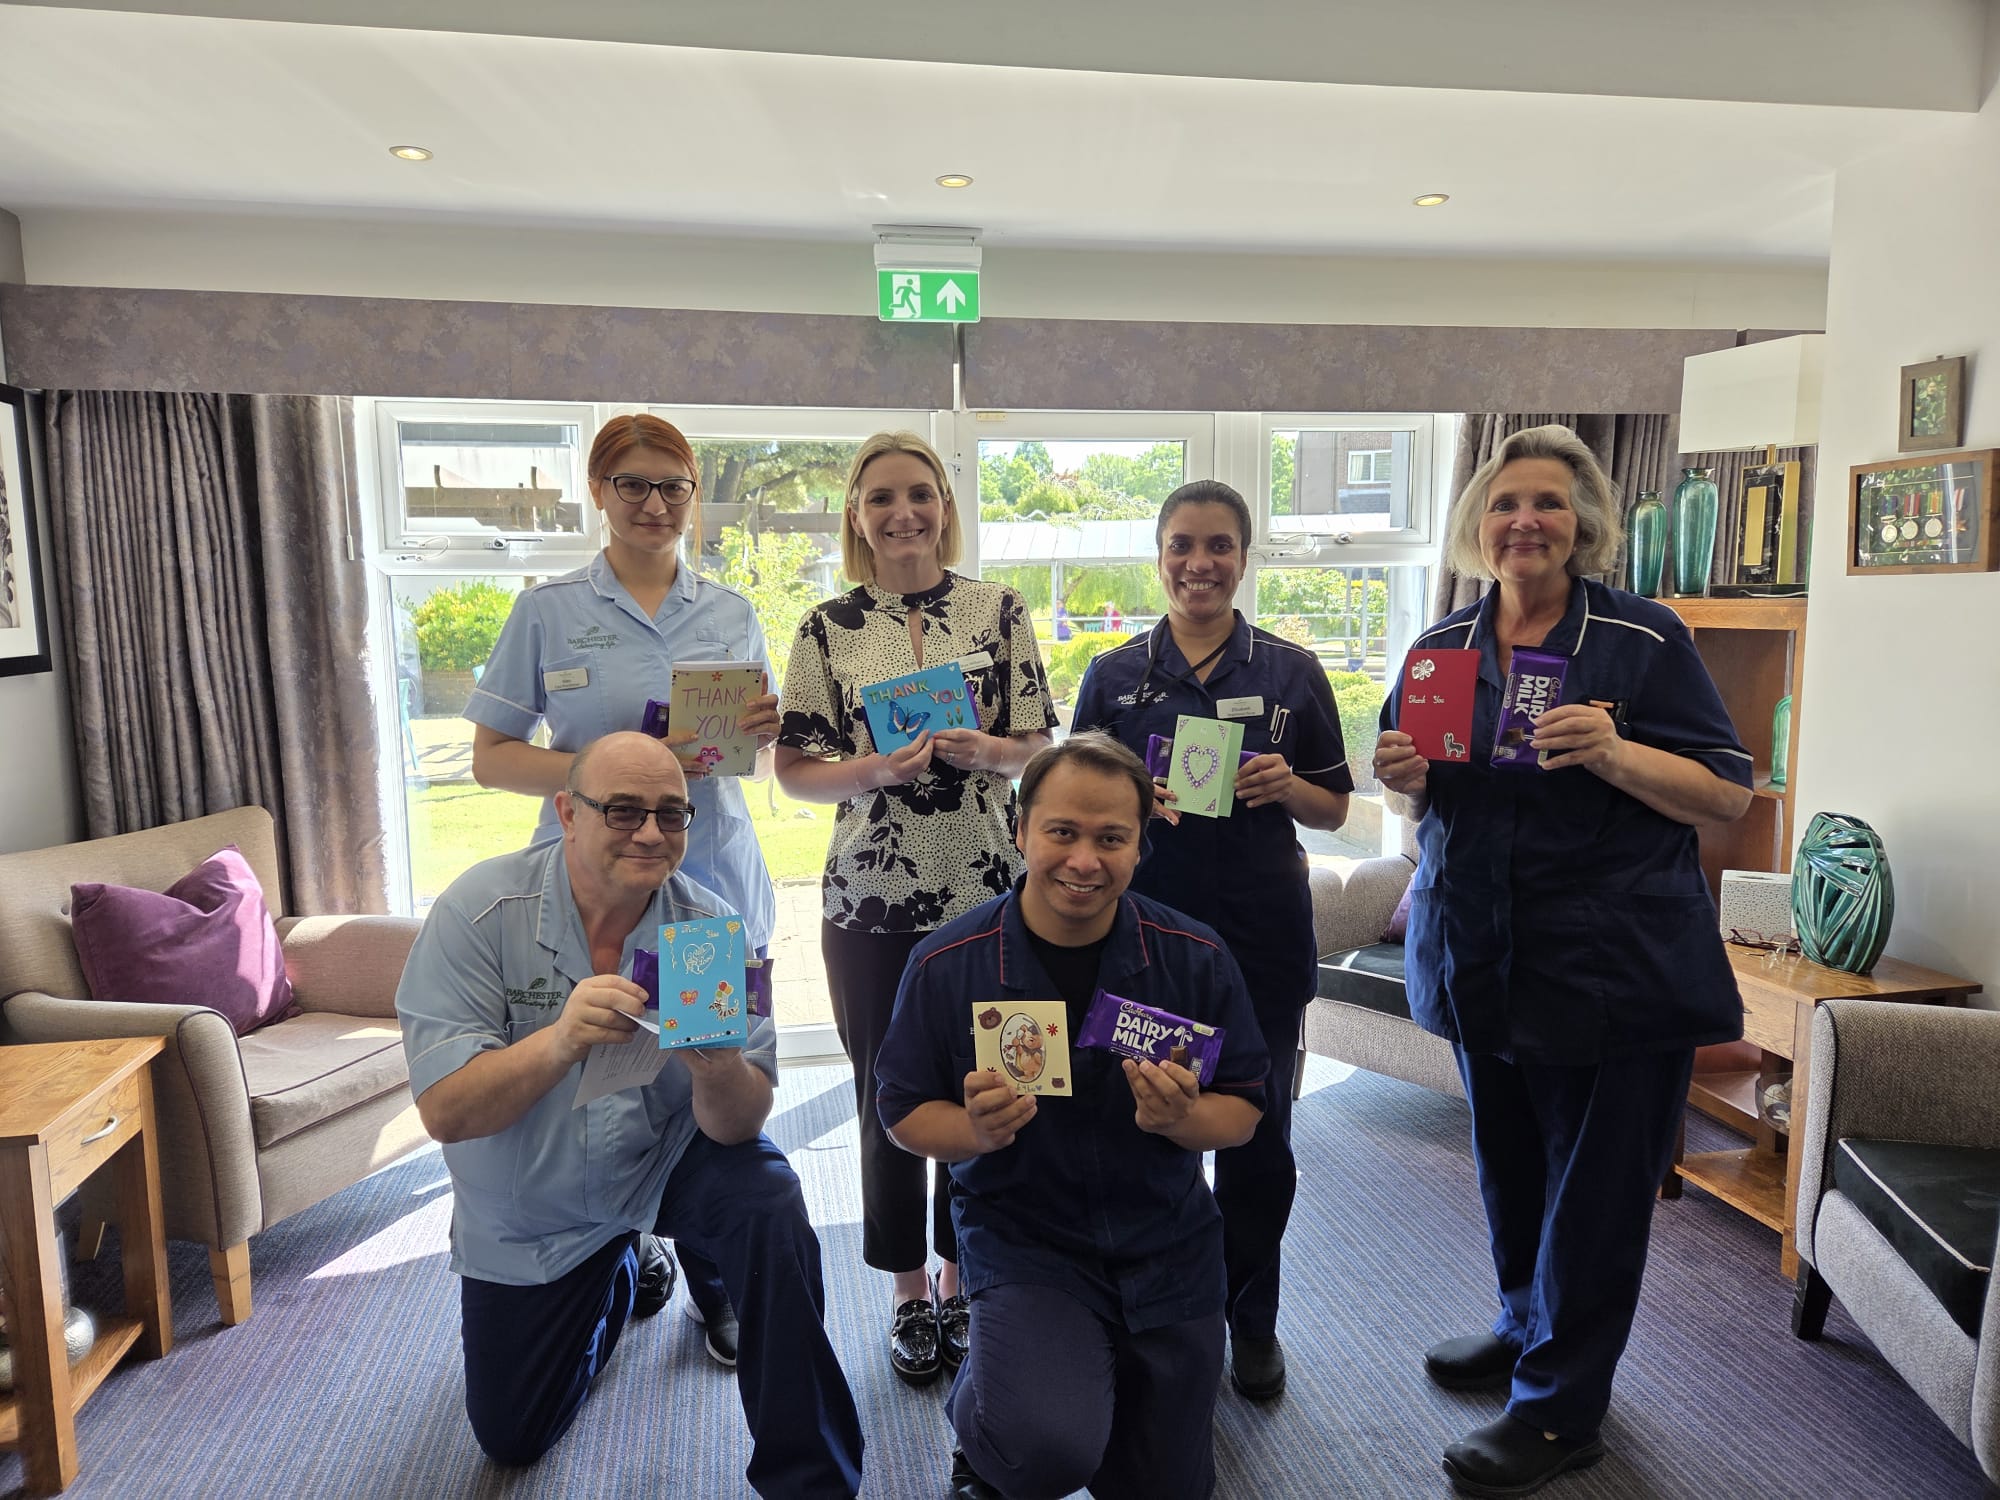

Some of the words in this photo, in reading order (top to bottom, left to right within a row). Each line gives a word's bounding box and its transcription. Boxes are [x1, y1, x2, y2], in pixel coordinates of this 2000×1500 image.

[682, 686, 747, 709] THANK
[868, 679, 930, 704] THANK
[928, 687, 965, 705] YOU
[1513, 673, 1536, 715] MILK
[695, 715, 738, 740] YOU
[505, 987, 565, 999] BARCHESTER
[1120, 1001, 1155, 1021] Cadbury
[1116, 1011, 1174, 1041] DAIRY
[1111, 1027, 1161, 1055] MILK
